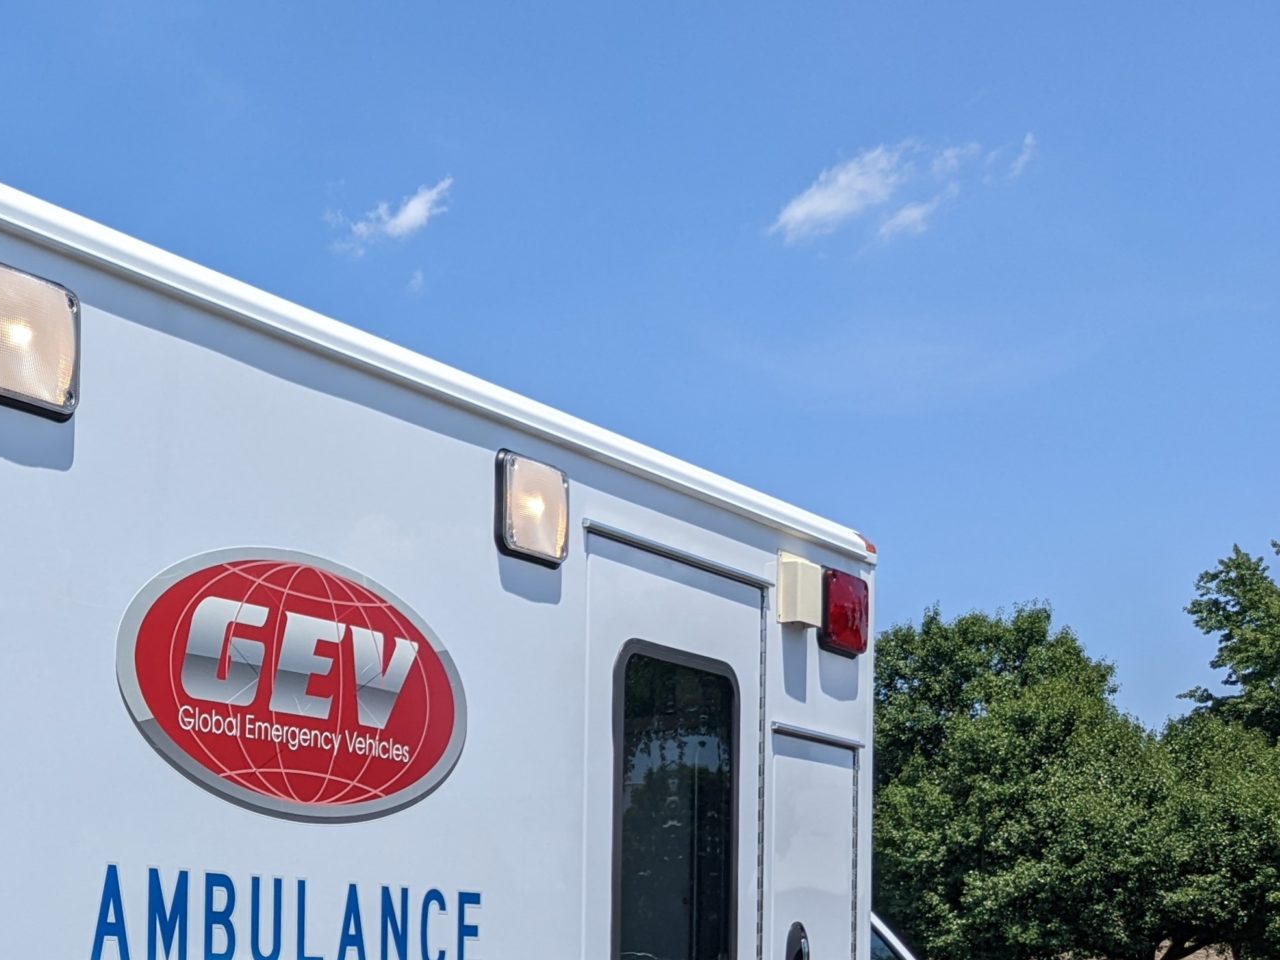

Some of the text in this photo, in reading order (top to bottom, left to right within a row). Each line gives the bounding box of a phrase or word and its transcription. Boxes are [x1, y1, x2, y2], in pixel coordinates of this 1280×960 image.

[180, 596, 419, 729] GEV
[178, 704, 410, 763] Global Emergency Vehicles
